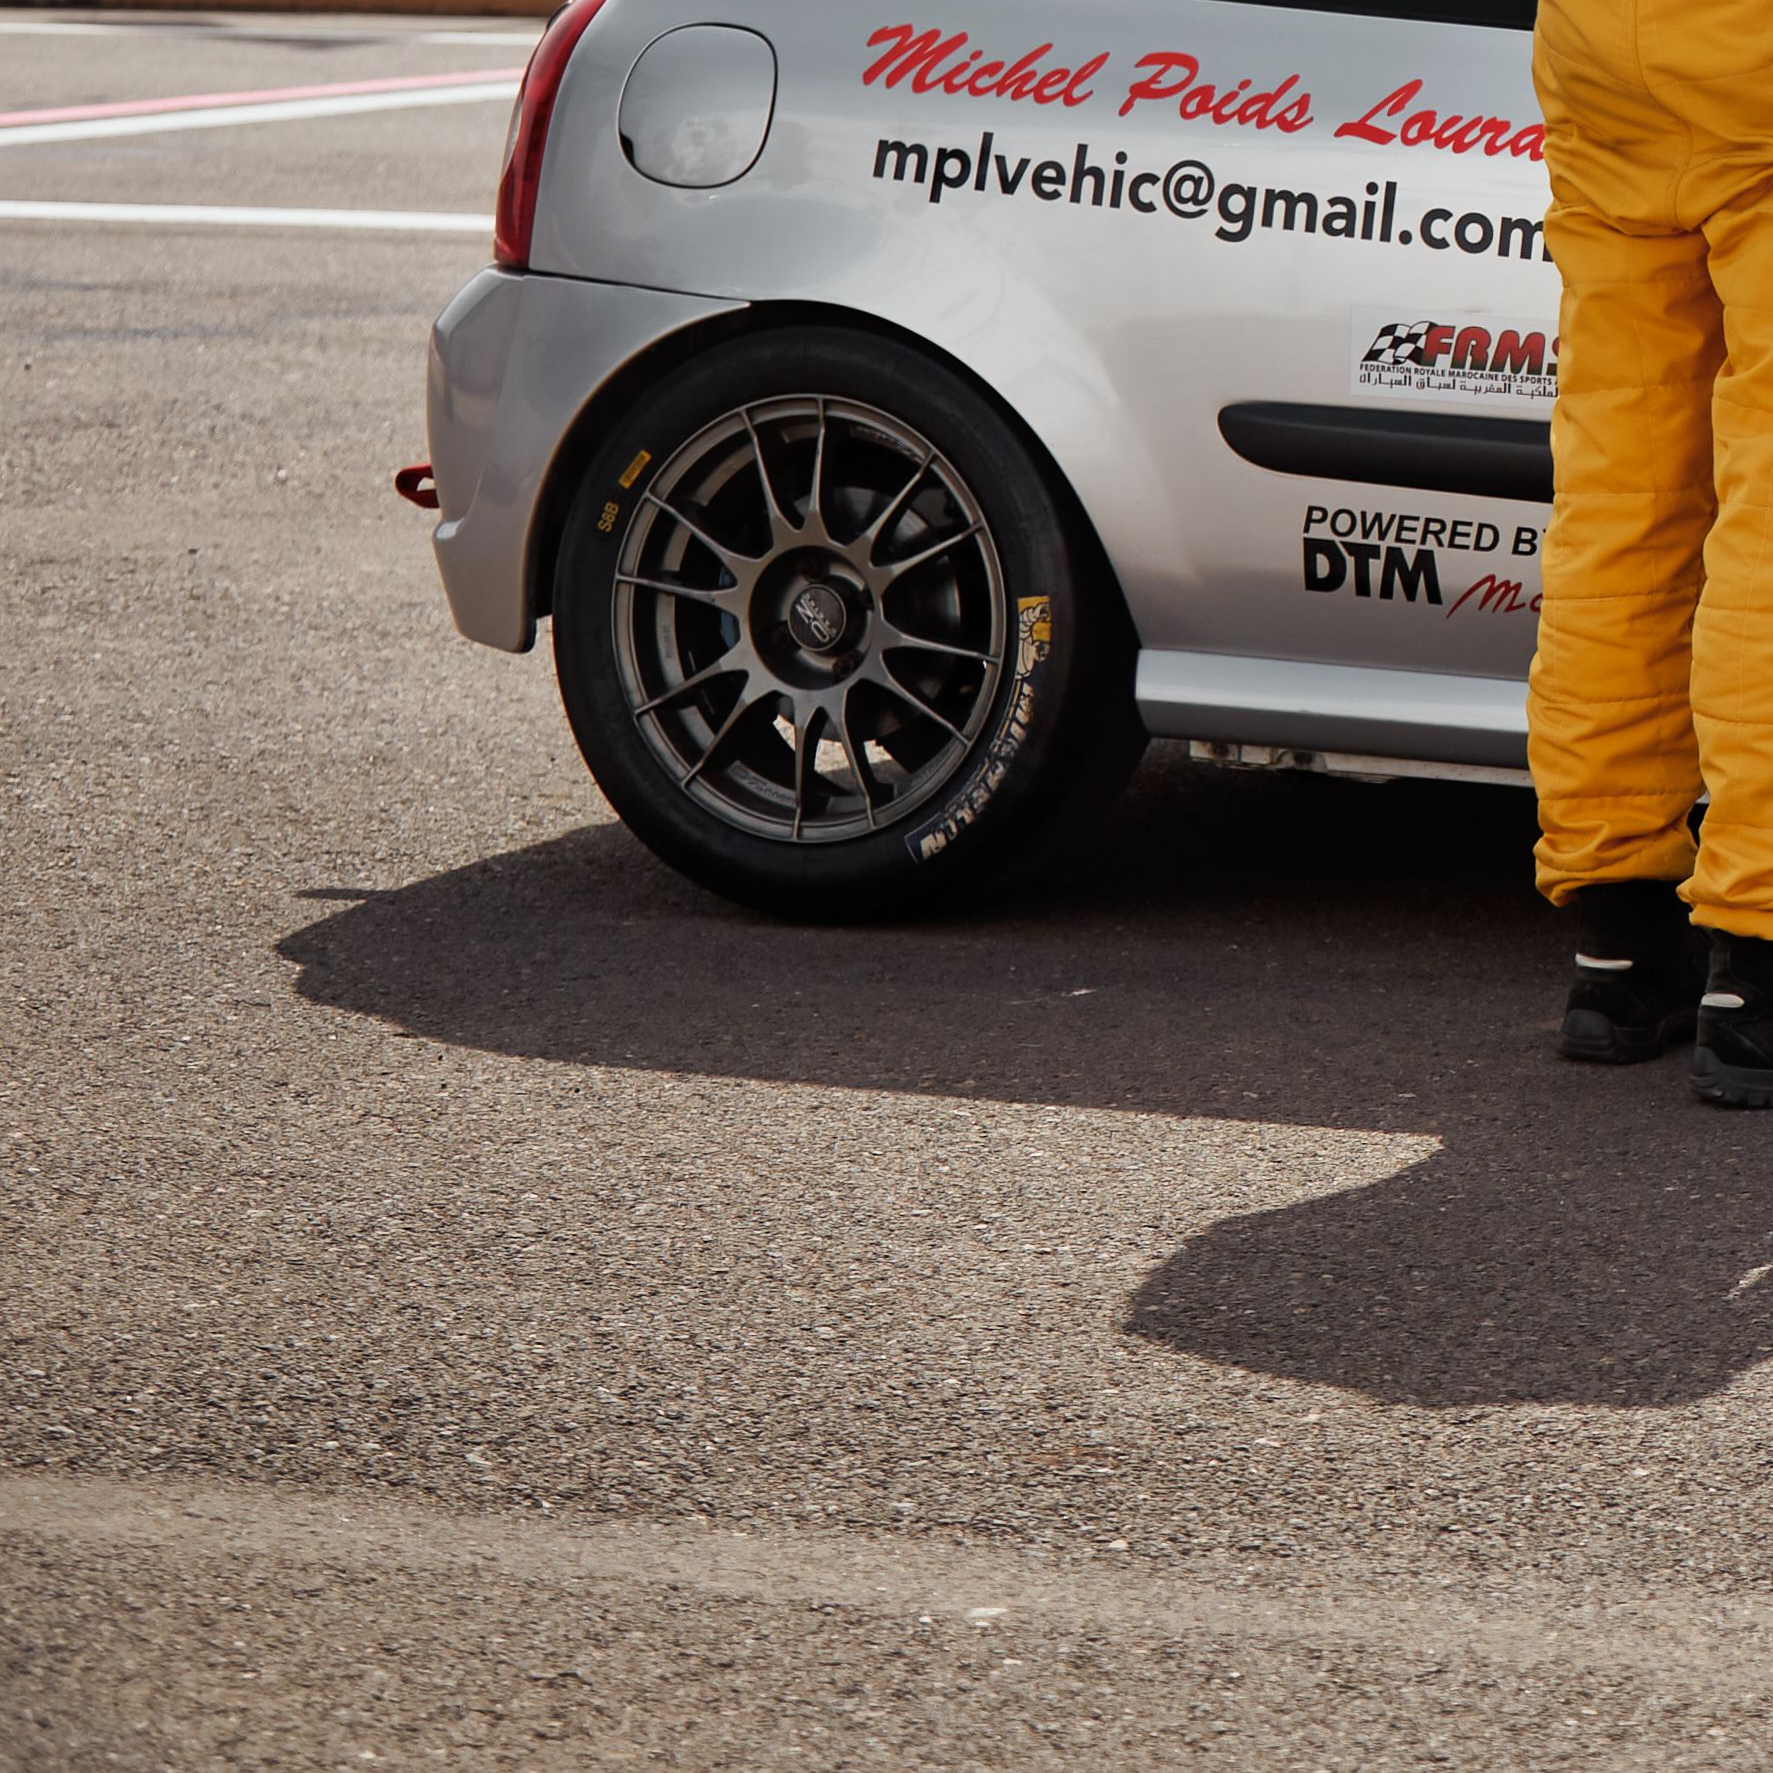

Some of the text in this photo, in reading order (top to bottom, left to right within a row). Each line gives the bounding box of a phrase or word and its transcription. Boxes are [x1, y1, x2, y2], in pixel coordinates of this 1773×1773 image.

[863, 23, 1110, 107] Michel
[1119, 50, 1314, 134] Poids
[872, 131, 1555, 263] mplvehic@gmail.com
[1303, 504, 1546, 557] POWERED B
[1303, 537, 1443, 606] DTM
